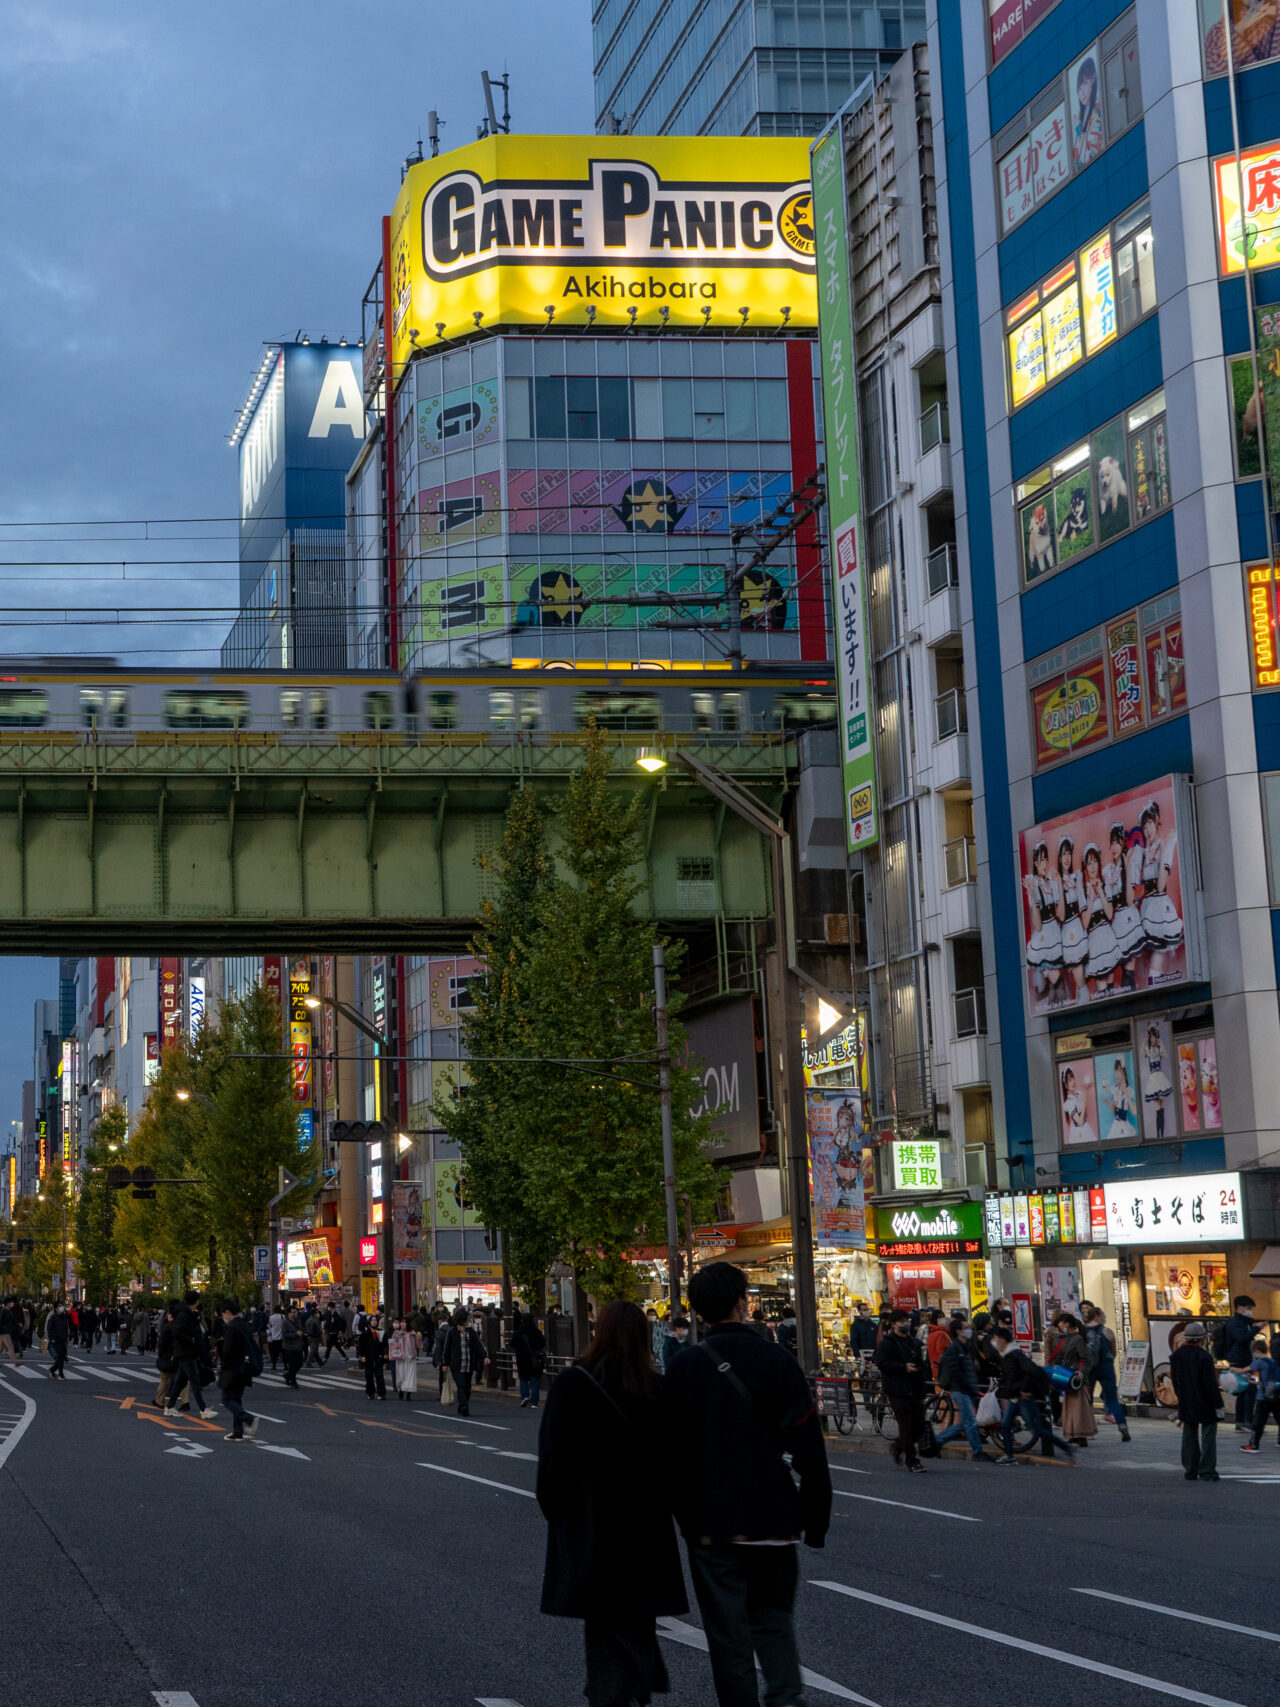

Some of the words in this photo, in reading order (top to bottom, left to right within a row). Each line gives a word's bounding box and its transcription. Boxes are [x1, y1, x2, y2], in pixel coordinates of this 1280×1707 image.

[993, 7, 1022, 46] HARE
[432, 182, 584, 266] GAME
[602, 170, 774, 251] PANIC
[562, 275, 717, 299] Akihabara
[292, 997, 308, 1007] アニ
[899, 1144, 936, 1165] 携帯
[900, 1167, 938, 1187] 買取
[1219, 1189, 1237, 1206] 24
[1131, 1191, 1207, 1229] 富士そば
[1220, 1209, 1238, 1225] 時間
[921, 1217, 959, 1236] mobile
